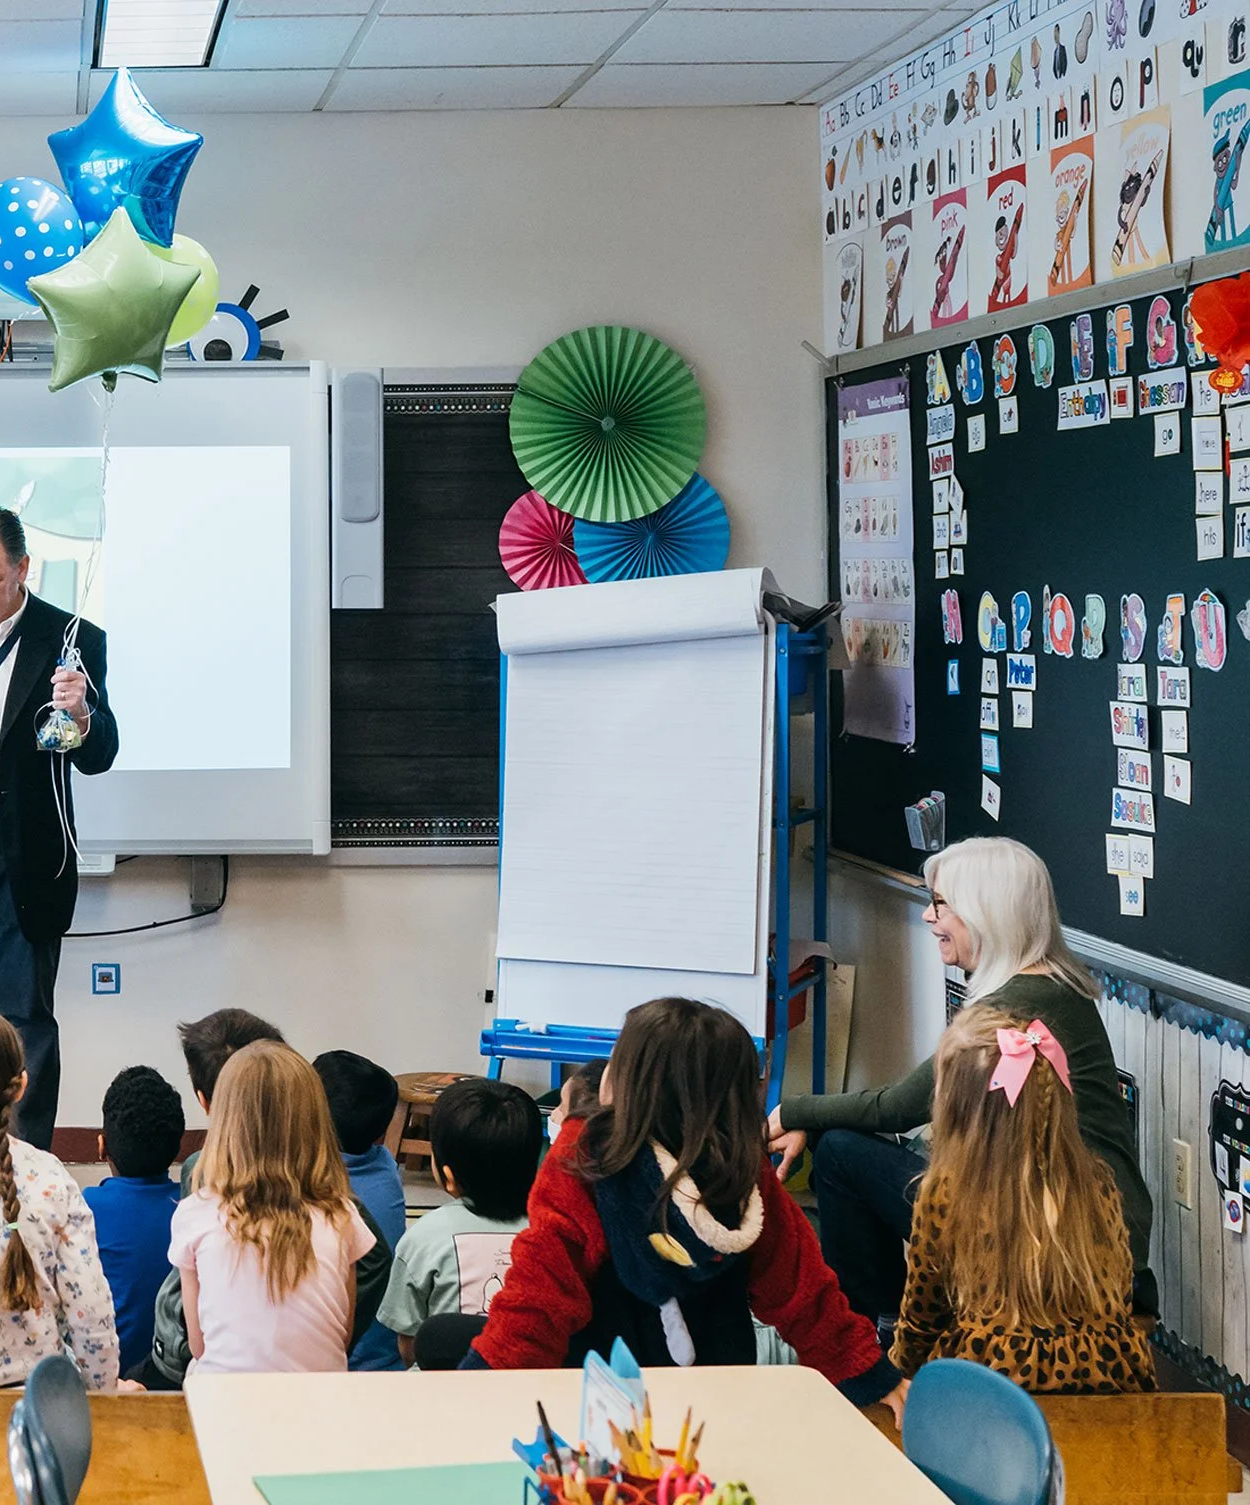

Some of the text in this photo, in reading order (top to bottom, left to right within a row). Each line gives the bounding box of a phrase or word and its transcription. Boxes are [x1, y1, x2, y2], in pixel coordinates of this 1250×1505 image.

[888, 73, 899, 100] Ee
[920, 52, 935, 89] Gg
[942, 38, 956, 69] Hh
[984, 14, 995, 57] Jj
[1212, 102, 1247, 139] green
[1054, 163, 1086, 189] orange
[892, 176, 902, 205] e
[998, 187, 1014, 211] red
[940, 210, 959, 236] pink
[886, 233, 907, 253] brown
[963, 346, 984, 404] B
[1075, 313, 1094, 381] E
[1114, 304, 1134, 375] F
[1147, 295, 1177, 368] G
[1014, 592, 1031, 651] P
[1049, 593, 1075, 658] Q
[1126, 593, 1146, 662] S
[1198, 600, 1227, 671] U
[1008, 658, 1034, 684] Peter
